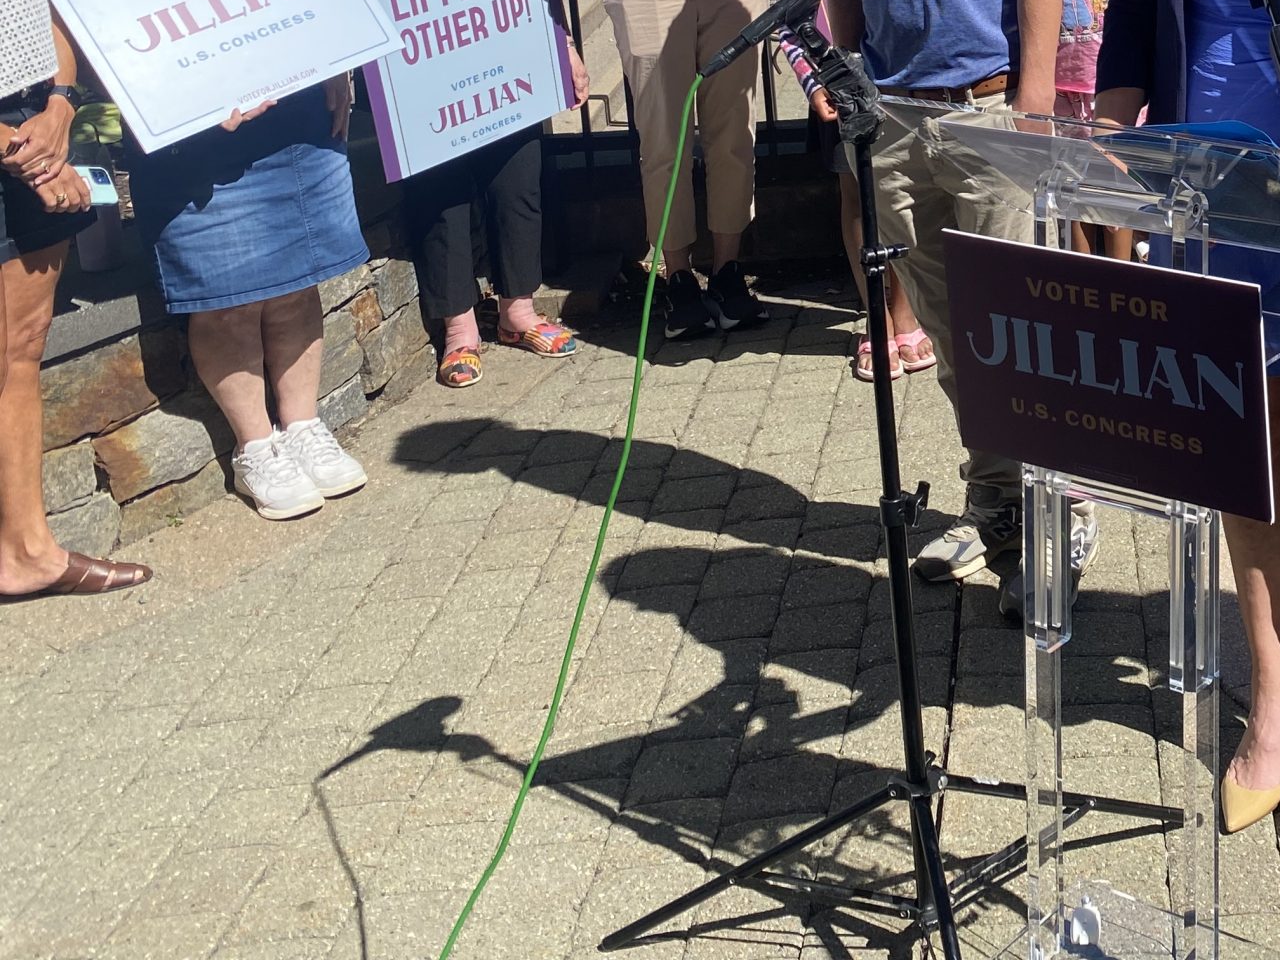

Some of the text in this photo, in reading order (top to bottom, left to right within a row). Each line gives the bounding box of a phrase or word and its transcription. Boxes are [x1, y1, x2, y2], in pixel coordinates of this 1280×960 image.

[177, 10, 316, 69] U.S. CONGRESS
[400, 6, 489, 65] OTHER
[237, 68, 318, 104] VOTEFORJILLIAN.COM
[429, 72, 533, 133] JILLIAN
[451, 65, 504, 91] VOTE FOR
[451, 136, 469, 147] U.S.
[472, 112, 522, 138] CONGRESS
[1025, 277, 1169, 322] VOTE FOR
[966, 312, 1245, 420] JILLIAN
[1011, 397, 1204, 455] U.S. CONGRESS
